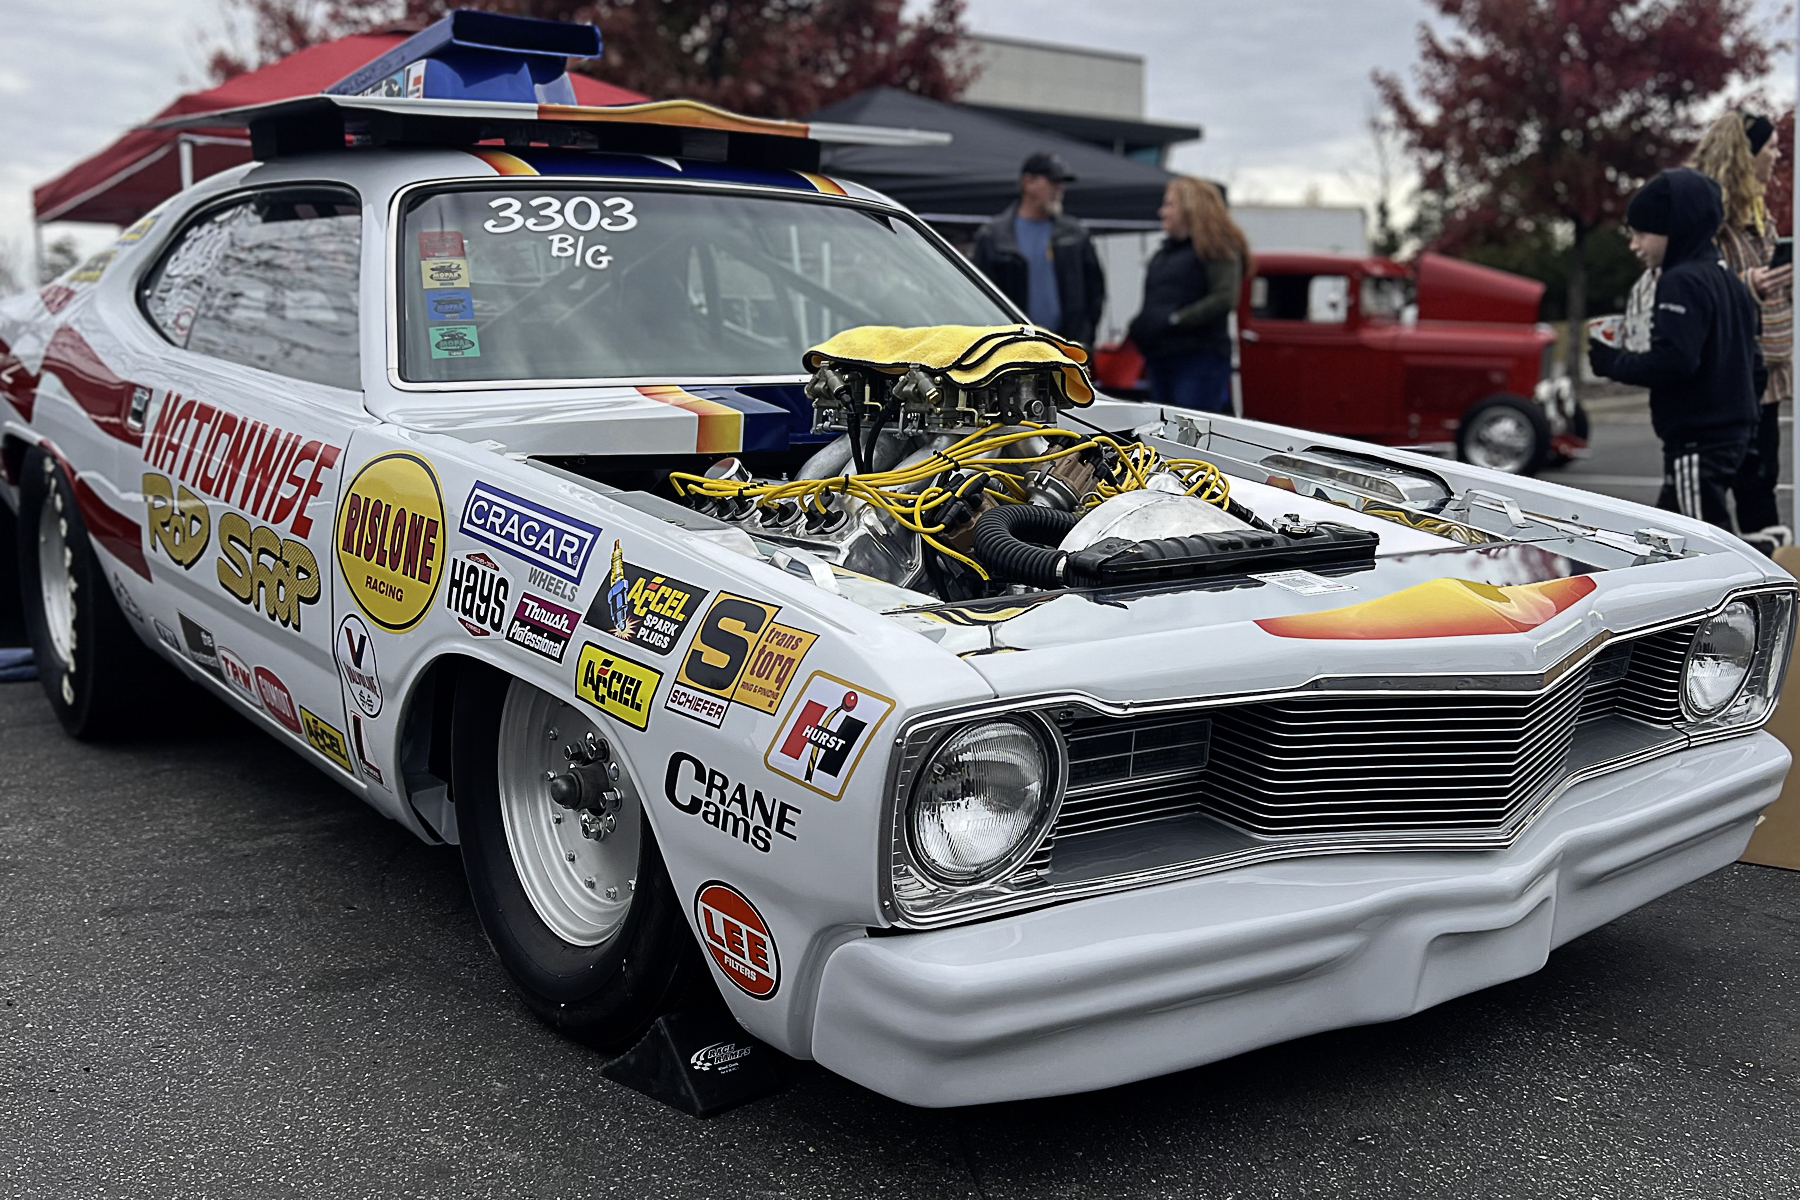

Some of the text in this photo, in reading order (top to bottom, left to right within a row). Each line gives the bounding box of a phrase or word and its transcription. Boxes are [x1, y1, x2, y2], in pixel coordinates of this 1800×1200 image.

[483, 196, 638, 234] 3303
[548, 234, 613, 270] B/G
[440, 340, 471, 348] MOPAR
[144, 390, 341, 539] NATIONWISE
[342, 493, 438, 584] RISLONE
[470, 500, 580, 566] CRAGAR
[365, 576, 404, 602] RACING
[529, 567, 578, 603] WHEELS
[627, 576, 691, 622] ACCEL
[522, 598, 572, 634] Thrush
[644, 614, 679, 636] SPARK
[509, 621, 565, 658] Professional
[637, 627, 670, 649] PLUGS
[685, 599, 767, 691] S
[765, 627, 803, 651] trans
[221, 655, 252, 692] TRW
[583, 658, 642, 712] ACCEL
[749, 644, 796, 691] torq
[670, 689, 724, 719] SCHIEFER
[305, 718, 347, 762] ACCEL
[802, 725, 846, 753] HURST
[702, 906, 770, 973] LEE
[724, 955, 757, 982] FILTERS
[708, 1043, 735, 1059] RACE
[714, 1047, 751, 1065] RAMPS
